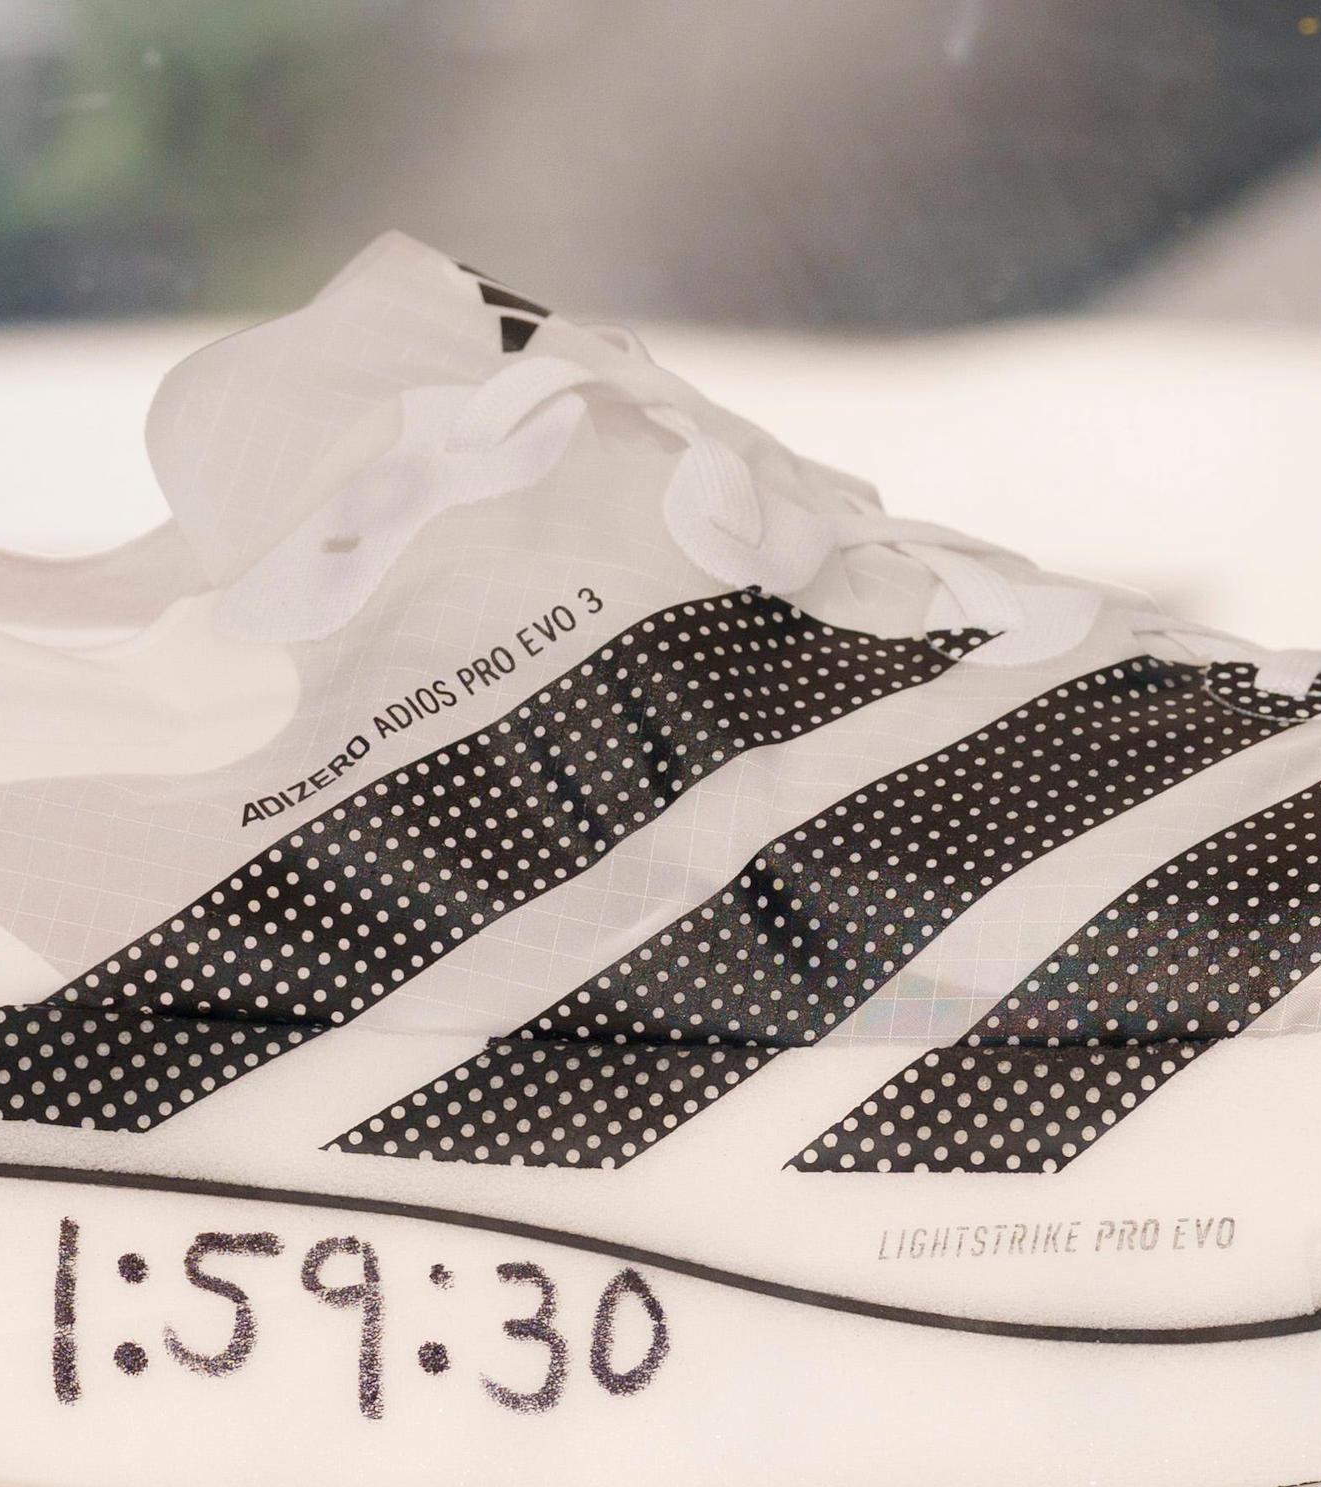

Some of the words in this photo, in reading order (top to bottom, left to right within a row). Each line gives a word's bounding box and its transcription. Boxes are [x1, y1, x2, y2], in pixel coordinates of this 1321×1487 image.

[240, 734, 371, 827] ADIZERO
[372, 680, 458, 739] ADIOS
[456, 646, 516, 696] PRO
[516, 604, 577, 657] EVO
[577, 587, 604, 614] 3
[53, 1217, 672, 1419] 1:59:30
[878, 1221, 1082, 1261] LIGHTSTRIKE
[1094, 1218, 1160, 1253] PRO
[1172, 1216, 1236, 1251] EVO
